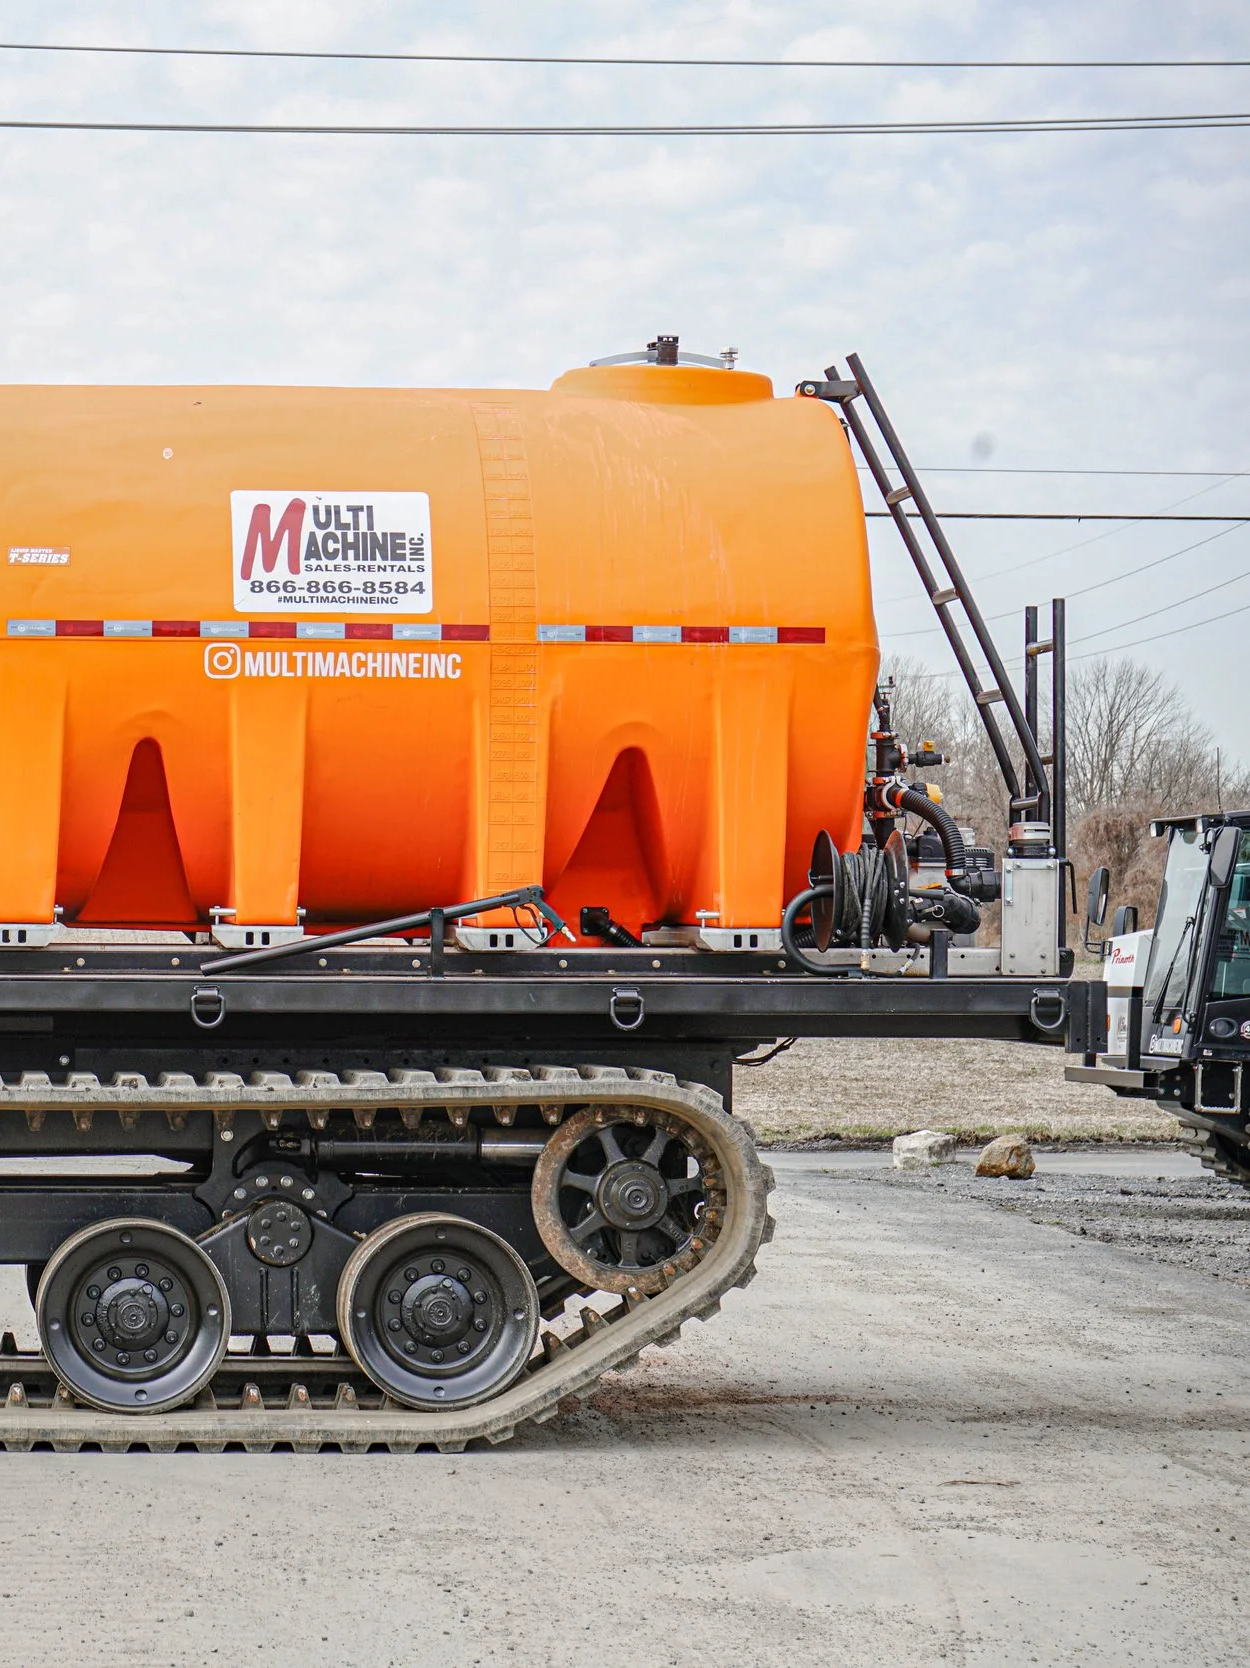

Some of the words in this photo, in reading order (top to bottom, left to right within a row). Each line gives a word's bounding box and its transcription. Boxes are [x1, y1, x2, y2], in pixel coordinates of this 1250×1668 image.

[408, 533, 425, 562] INC.
[9, 553, 69, 564] T-SERIES
[304, 564, 426, 573] SALES-RENTALS
[249, 580, 426, 595] 866-866-8584
[277, 595, 399, 605] #MULTIMACHINEINC
[244, 651, 462, 679] MULTIMACHINEINC
